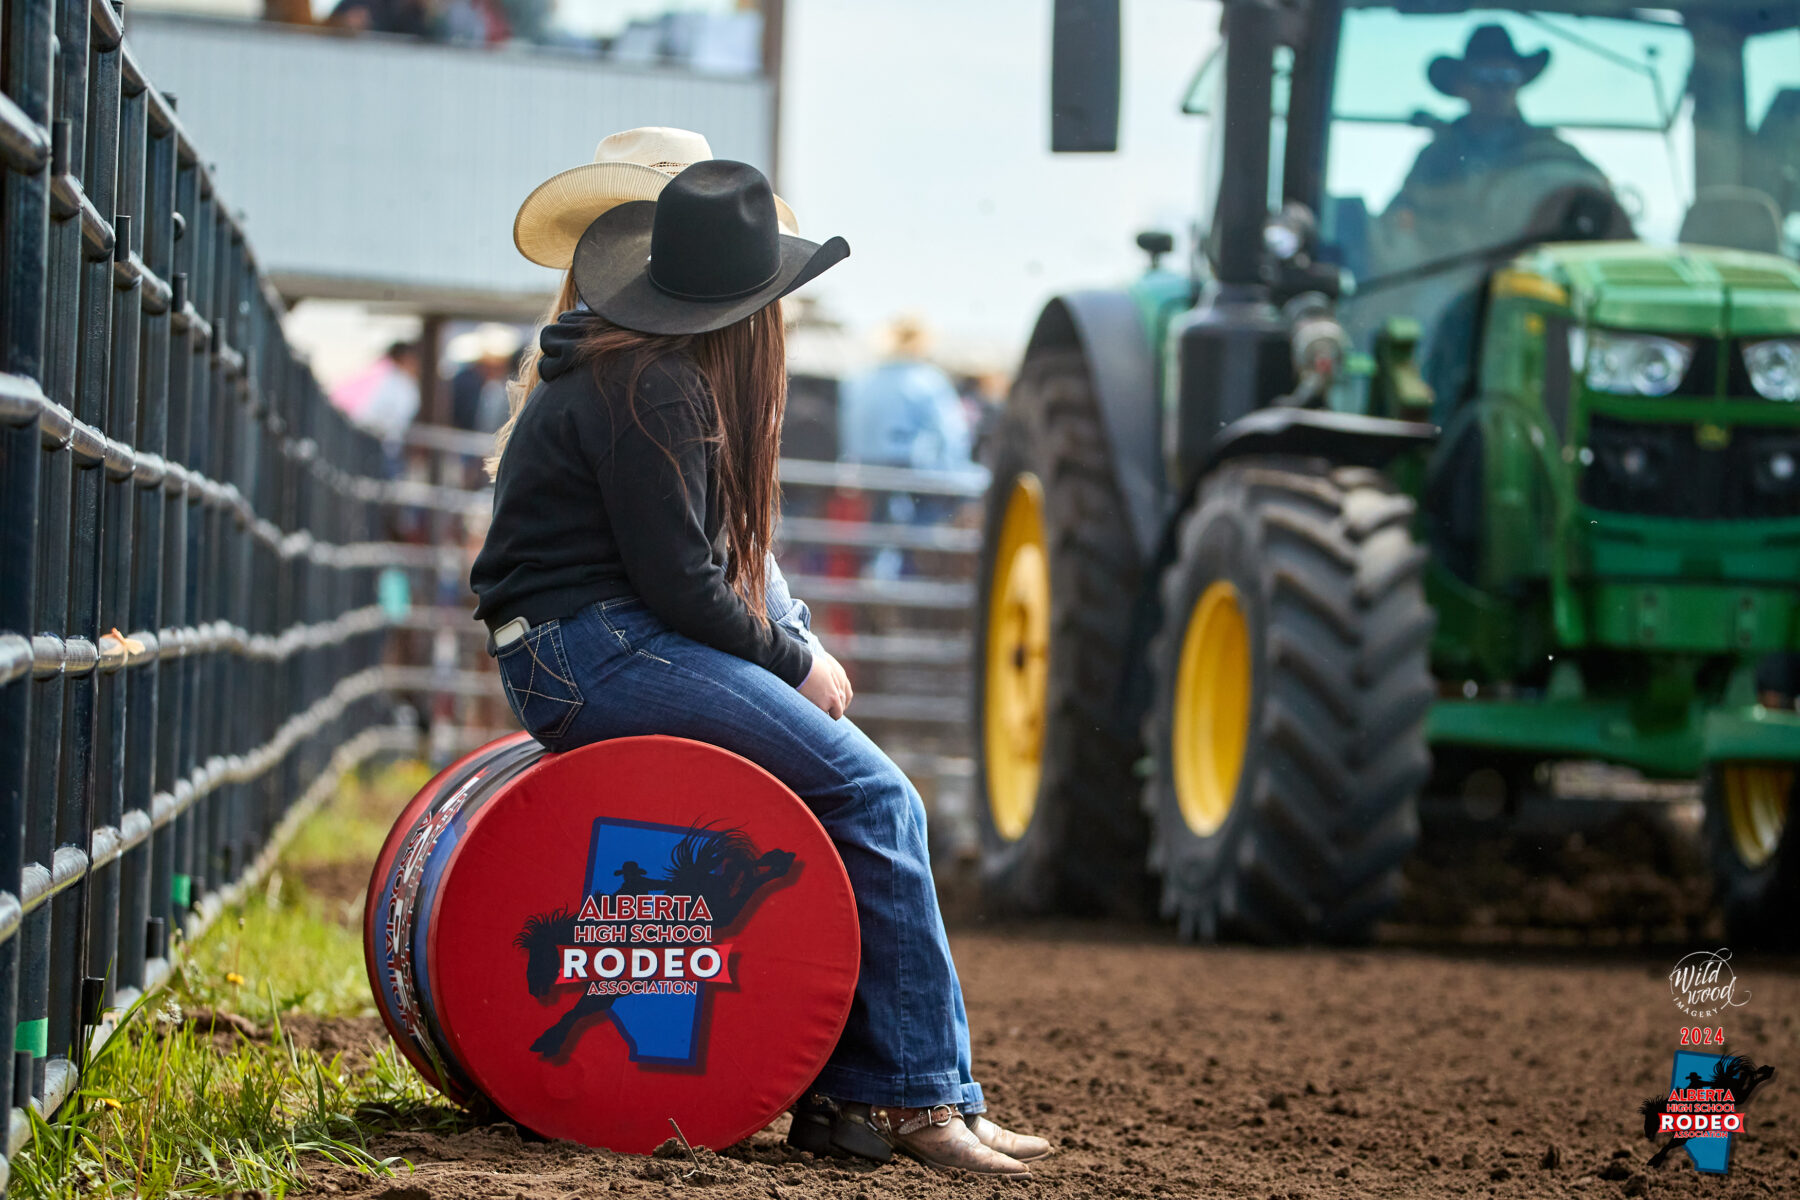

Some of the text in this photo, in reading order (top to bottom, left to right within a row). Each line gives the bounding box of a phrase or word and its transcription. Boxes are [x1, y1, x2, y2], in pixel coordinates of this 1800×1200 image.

[577, 894, 713, 922] ALBERTA
[385, 810, 432, 1036] ASSOCIATION
[574, 923, 714, 943] HIGH SCHOOL
[563, 947, 722, 979] RODEO
[587, 980, 698, 996] ASSOCIATION
